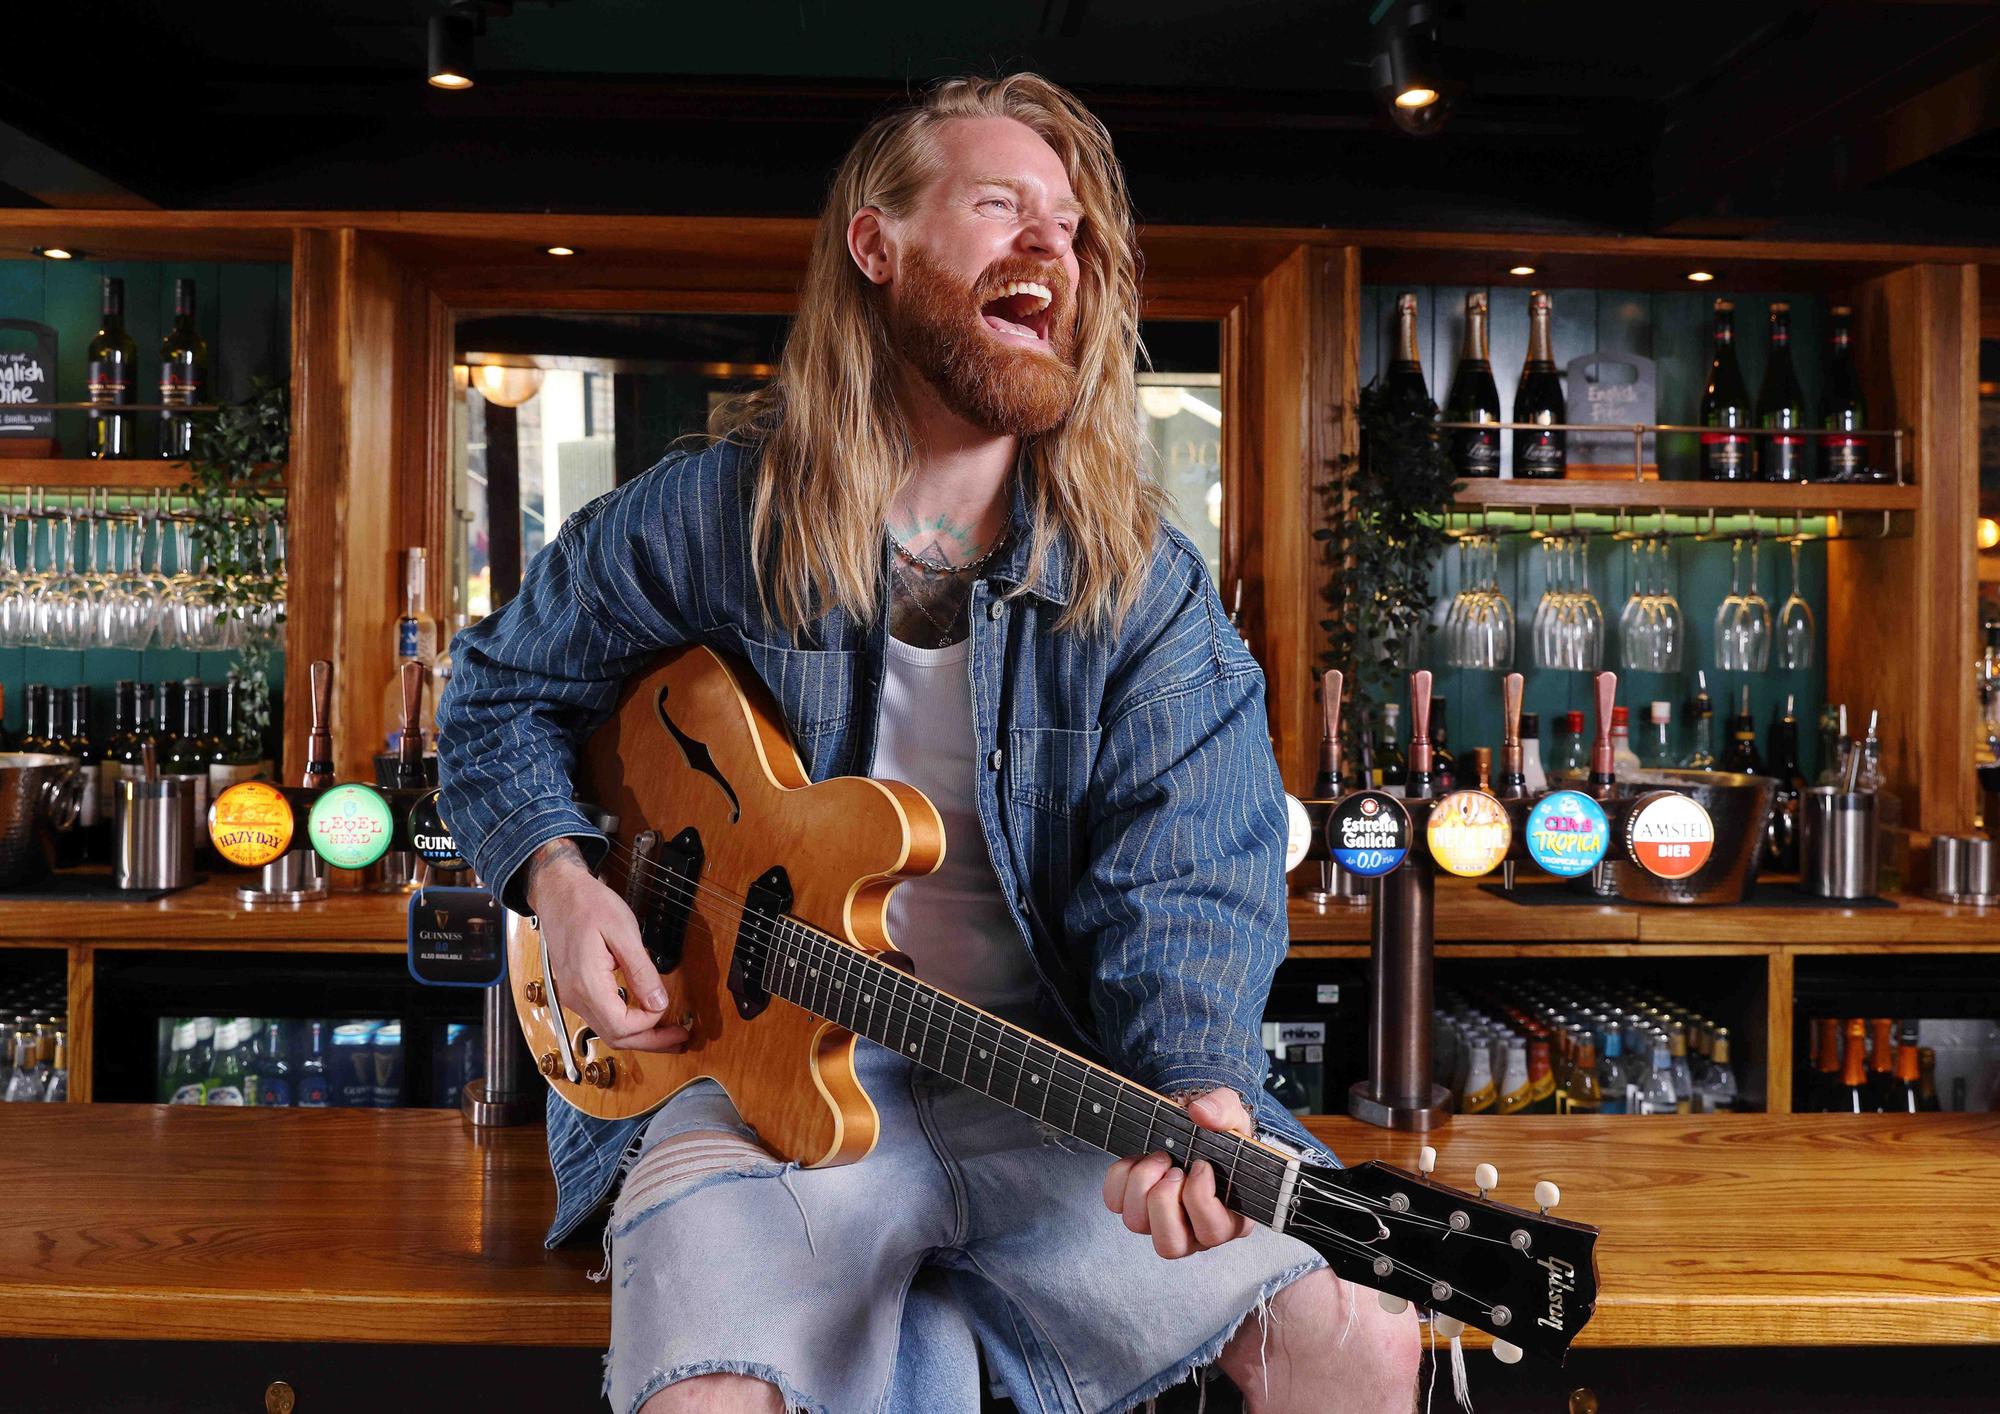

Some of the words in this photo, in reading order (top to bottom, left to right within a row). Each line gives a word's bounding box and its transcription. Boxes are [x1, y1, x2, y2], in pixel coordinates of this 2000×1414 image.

[319, 816, 382, 833] LEVEL
[1641, 823, 1705, 838] AMSTEL
[219, 831, 255, 848] HAZY
[255, 831, 283, 850] DAY
[330, 833, 371, 845] HEAD
[1343, 832, 1396, 848] Galicia
[1532, 831, 1600, 856] TROPICA
[1657, 844, 1691, 858] BIER
[419, 930, 463, 941] GUINNESS
[1282, 1027, 1320, 1039] rhino
[1537, 1256, 1575, 1331] Gibson
